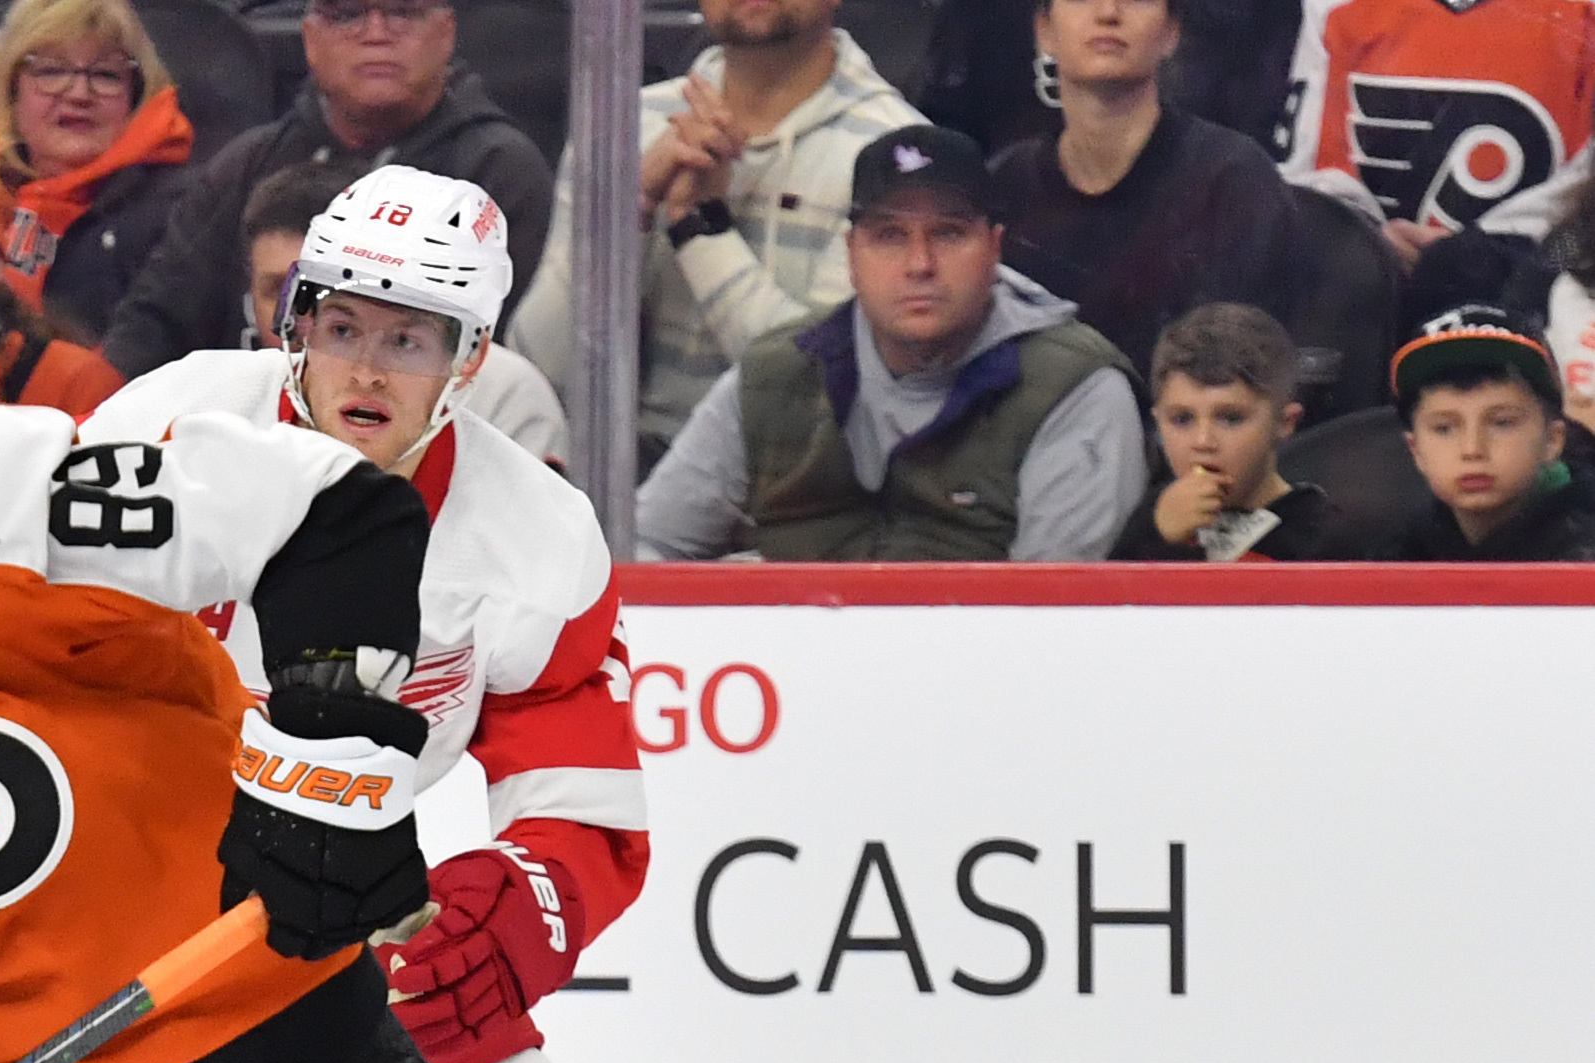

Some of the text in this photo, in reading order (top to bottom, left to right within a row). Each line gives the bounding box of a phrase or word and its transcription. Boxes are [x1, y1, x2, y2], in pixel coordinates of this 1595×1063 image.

[369, 201, 413, 227] 18
[342, 245, 405, 268] BAUER
[234, 743, 394, 811] AUER
[694, 836, 1186, 996] CASH
